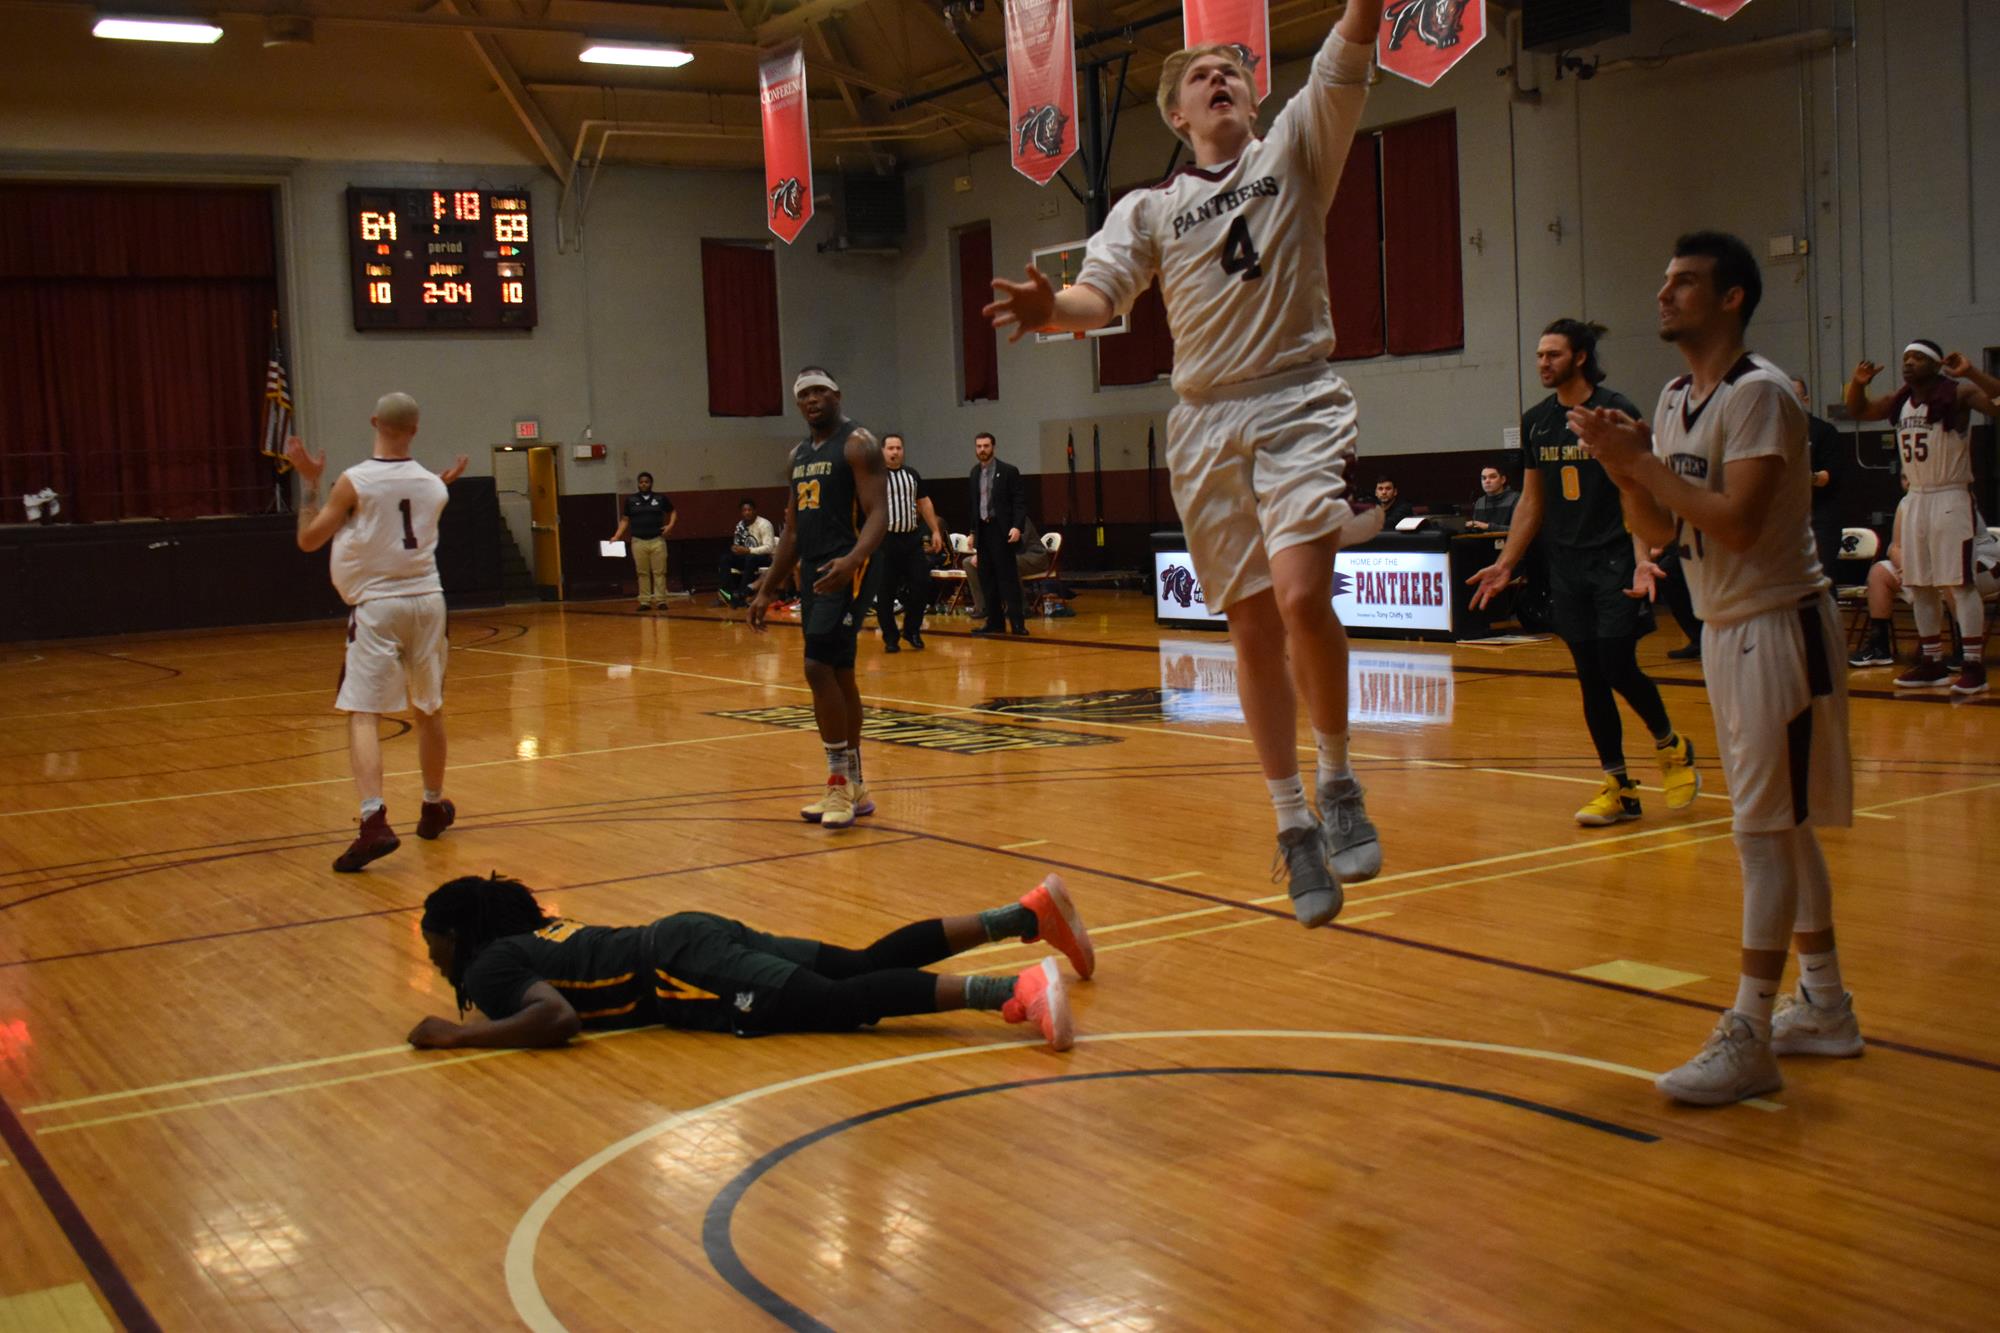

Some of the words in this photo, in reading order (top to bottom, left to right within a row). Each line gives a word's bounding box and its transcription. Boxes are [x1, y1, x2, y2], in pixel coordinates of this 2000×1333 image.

[1173, 176, 1279, 240] PANTHERS
[361, 211, 397, 241] 64
[495, 214, 529, 242] 69
[428, 241, 463, 255] period
[1221, 214, 1262, 282] 4
[429, 262, 464, 277] player
[369, 282, 392, 304] 10
[502, 282, 523, 304] 10
[1901, 433, 1928, 463] 55
[399, 498, 418, 549] 1
[1350, 558, 1370, 566] HOME
[1373, 558, 1382, 566] OF
[1385, 558, 1398, 566] THE
[1355, 571, 1443, 606] PANTHERS
